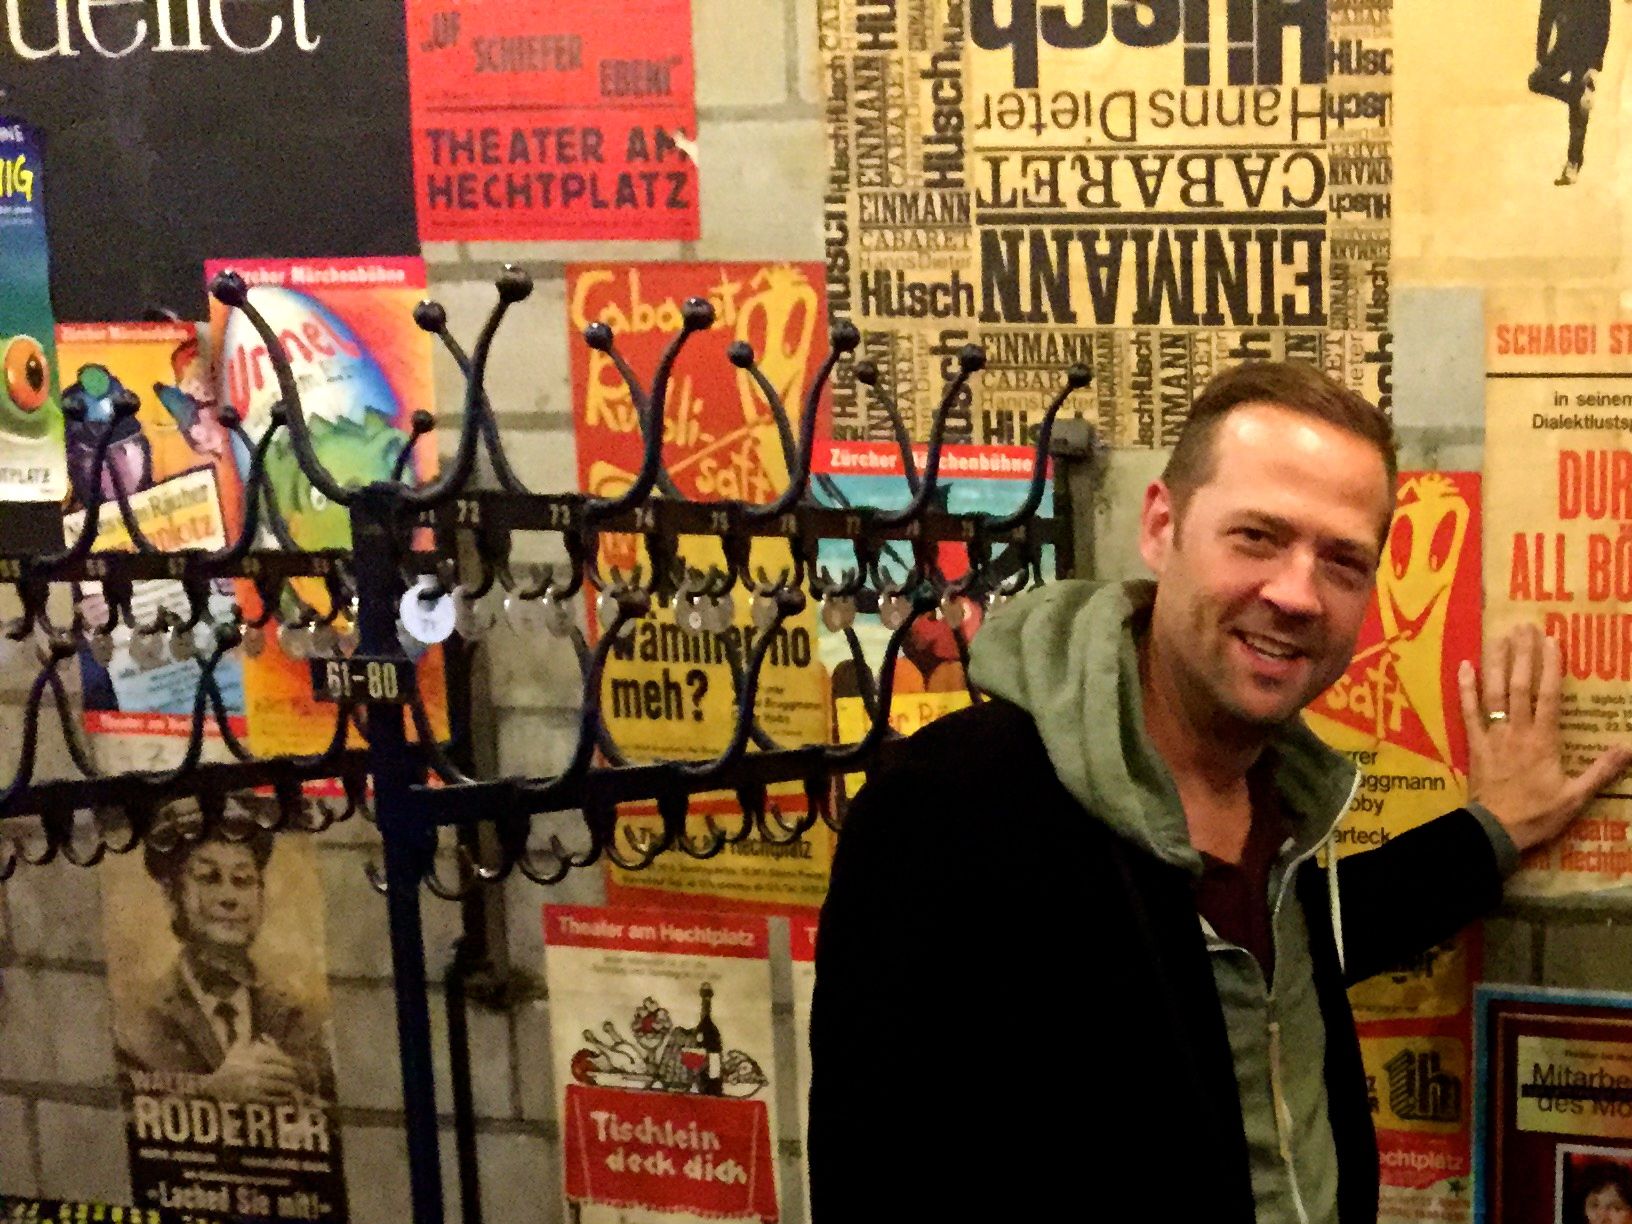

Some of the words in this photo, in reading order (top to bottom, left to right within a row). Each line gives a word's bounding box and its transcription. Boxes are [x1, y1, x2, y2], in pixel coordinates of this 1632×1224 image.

[974, 88, 1138, 143] Dieter
[1148, 87, 1327, 141] Hanns
[426, 126, 605, 165] THEATER
[427, 171, 691, 210] HECHTPLATZ
[976, 150, 1328, 209] CABARET
[859, 191, 972, 225] EINMANN
[859, 269, 976, 319] Hüsch
[979, 228, 1328, 325] EINMANN
[1496, 323, 1597, 356] SCHAGGI
[1553, 390, 1569, 407] in
[1509, 532, 1574, 603] ALL
[326, 661, 398, 699] 61-80
[611, 668, 709, 721] meh?
[558, 916, 624, 940] Theater
[627, 923, 657, 940] am
[589, 1111, 721, 1152] Tischlein
[605, 1146, 676, 1178] deck
[683, 1153, 748, 1185] dich
